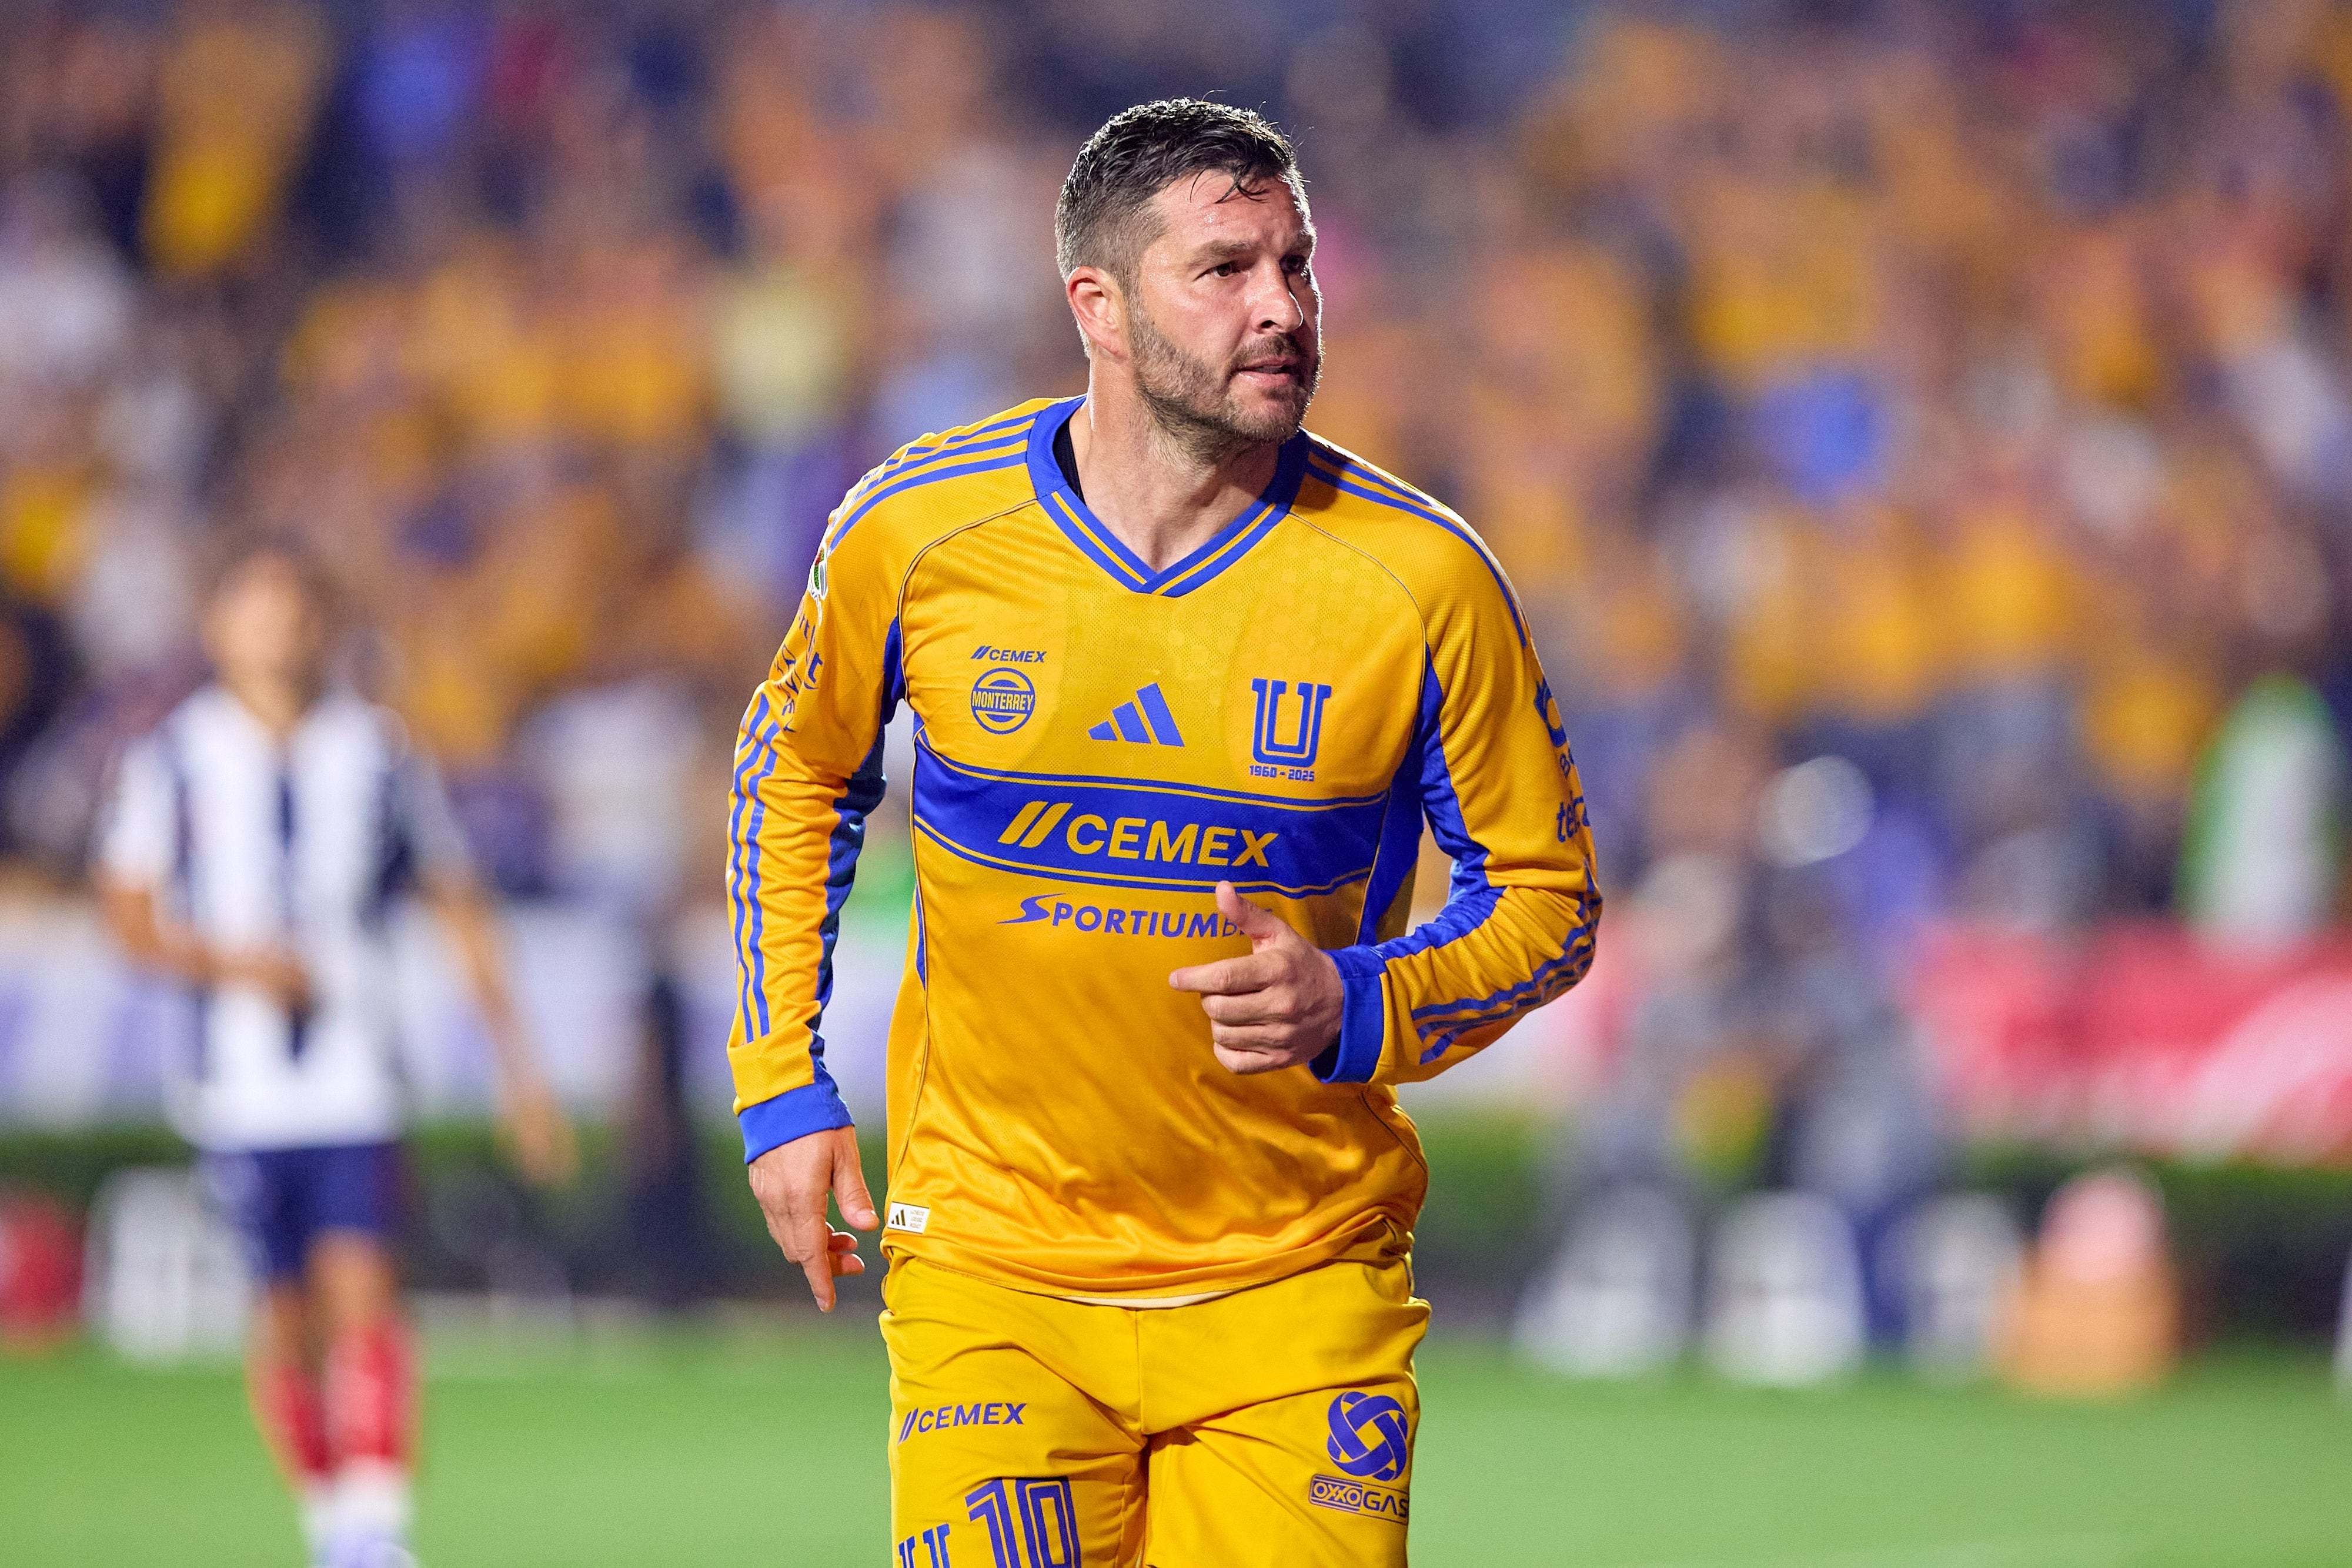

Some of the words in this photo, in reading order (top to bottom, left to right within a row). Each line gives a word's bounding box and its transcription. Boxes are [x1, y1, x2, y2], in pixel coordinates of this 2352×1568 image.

[989, 648, 1047, 663] CEMEX
[971, 691, 1034, 711] MONTERREY
[1251, 678, 1332, 768] U
[1250, 765, 1277, 778] 1960
[1287, 768, 1315, 782] 2025
[1066, 814, 1279, 868] CEMEX
[918, 1403, 1027, 1433] CEMEX
[1313, 1482, 1362, 1505] OXXO
[1363, 1491, 1408, 1519] GAS
[965, 1476, 1081, 1568] 10
